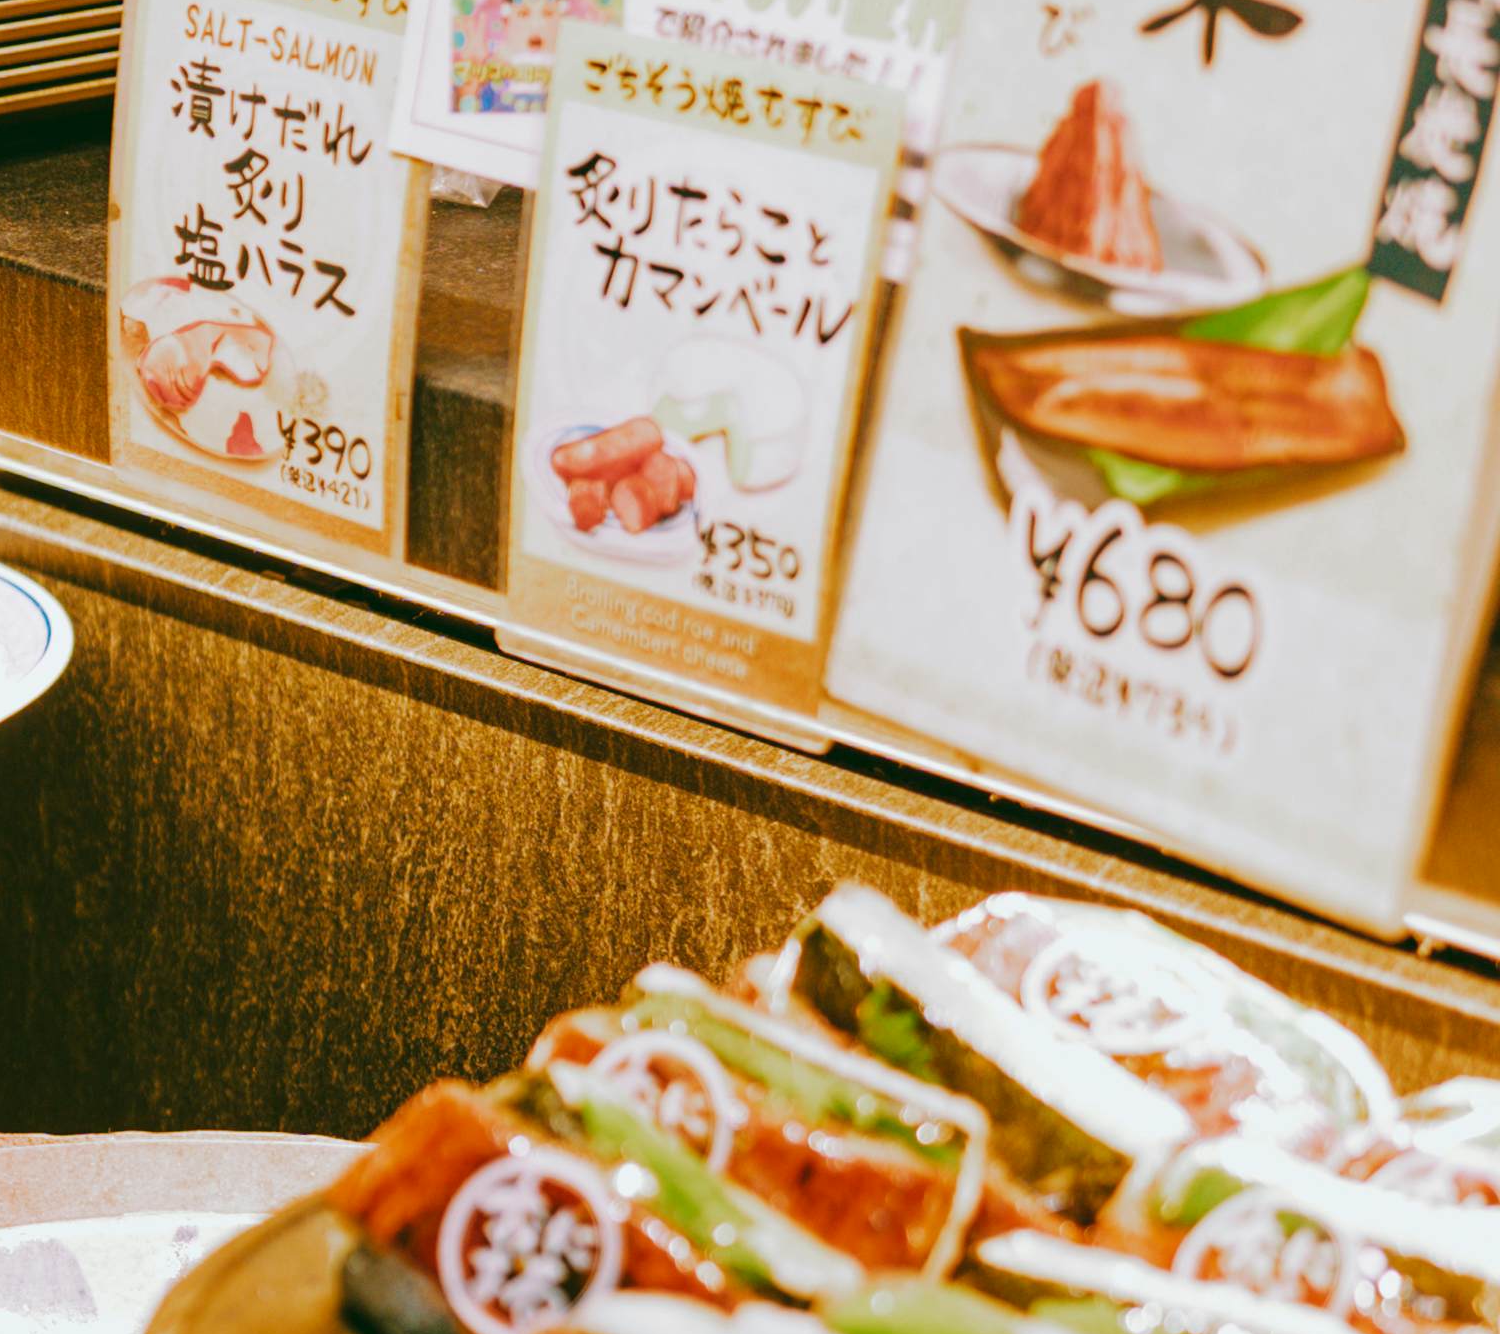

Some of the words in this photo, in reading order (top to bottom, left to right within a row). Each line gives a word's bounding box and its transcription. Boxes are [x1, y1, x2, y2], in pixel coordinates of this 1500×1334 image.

[184, 3, 379, 88] SALT-SALMON
[167, 56, 373, 167] 漬けだれ
[583, 54, 874, 148] ごちそう焼むすび
[223, 147, 306, 233] 炙り
[566, 151, 834, 267] 炙りたらこと
[172, 203, 358, 319] 塩ハラス
[590, 238, 856, 348] カマンベール
[276, 410, 372, 481] ¥390
[694, 511, 801, 581] ¥350
[1026, 509, 1262, 679] ¥680
